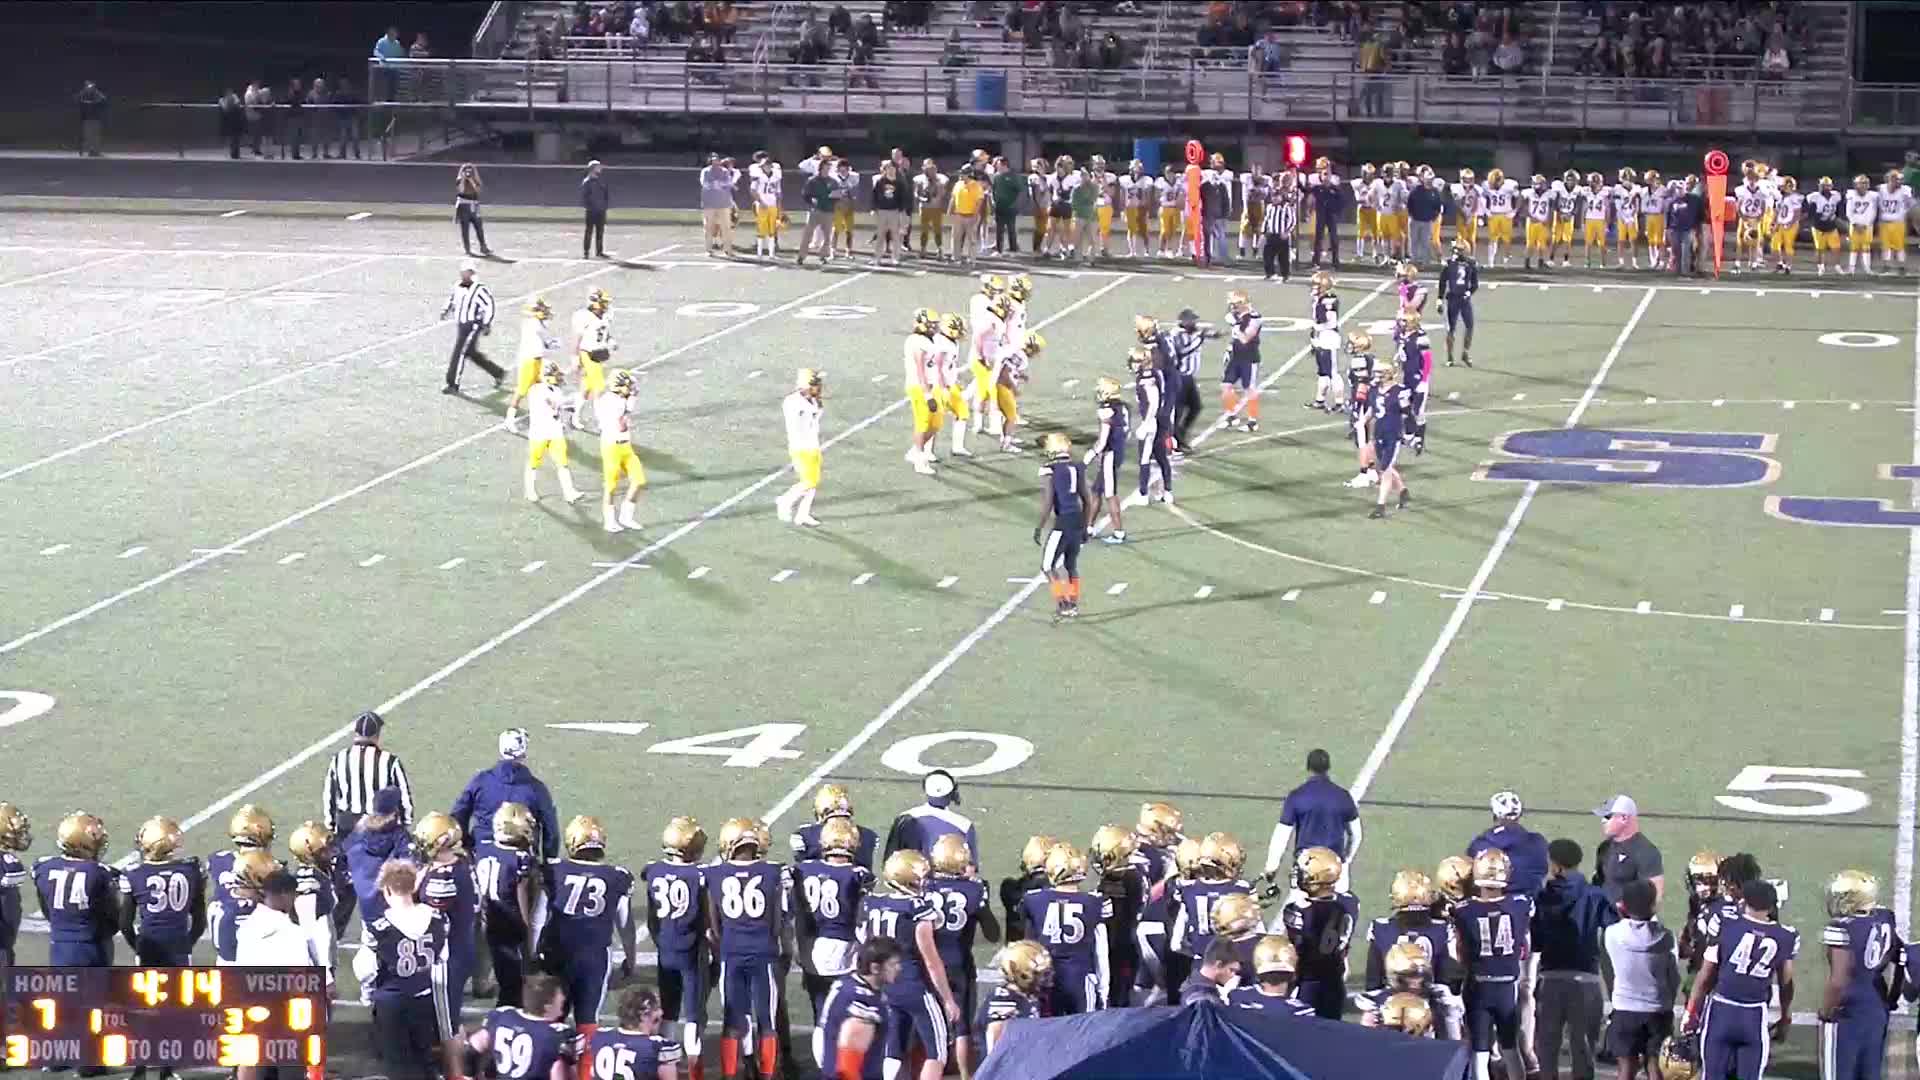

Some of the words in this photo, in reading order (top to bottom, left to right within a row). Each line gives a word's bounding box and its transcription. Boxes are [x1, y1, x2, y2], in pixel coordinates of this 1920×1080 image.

[1532, 200, 1548, 215] 73
[1456, 269, 1467, 285] 2
[1068, 465, 1078, 494] 1
[1713, 765, 1871, 816] 5
[48, 869, 90, 911] 74
[146, 872, 189, 913] 30
[563, 874, 607, 917] 73
[652, 877, 690, 919] 39
[721, 875, 766, 919] 86
[803, 875, 840, 919] 98
[1042, 902, 1085, 944] 45
[1476, 914, 1514, 956] 14
[396, 933, 435, 977] 85
[1729, 932, 1778, 978] 42
[1864, 923, 1891, 970] 62
[495, 1026, 533, 1079] 59
[594, 1045, 636, 1080] 95
